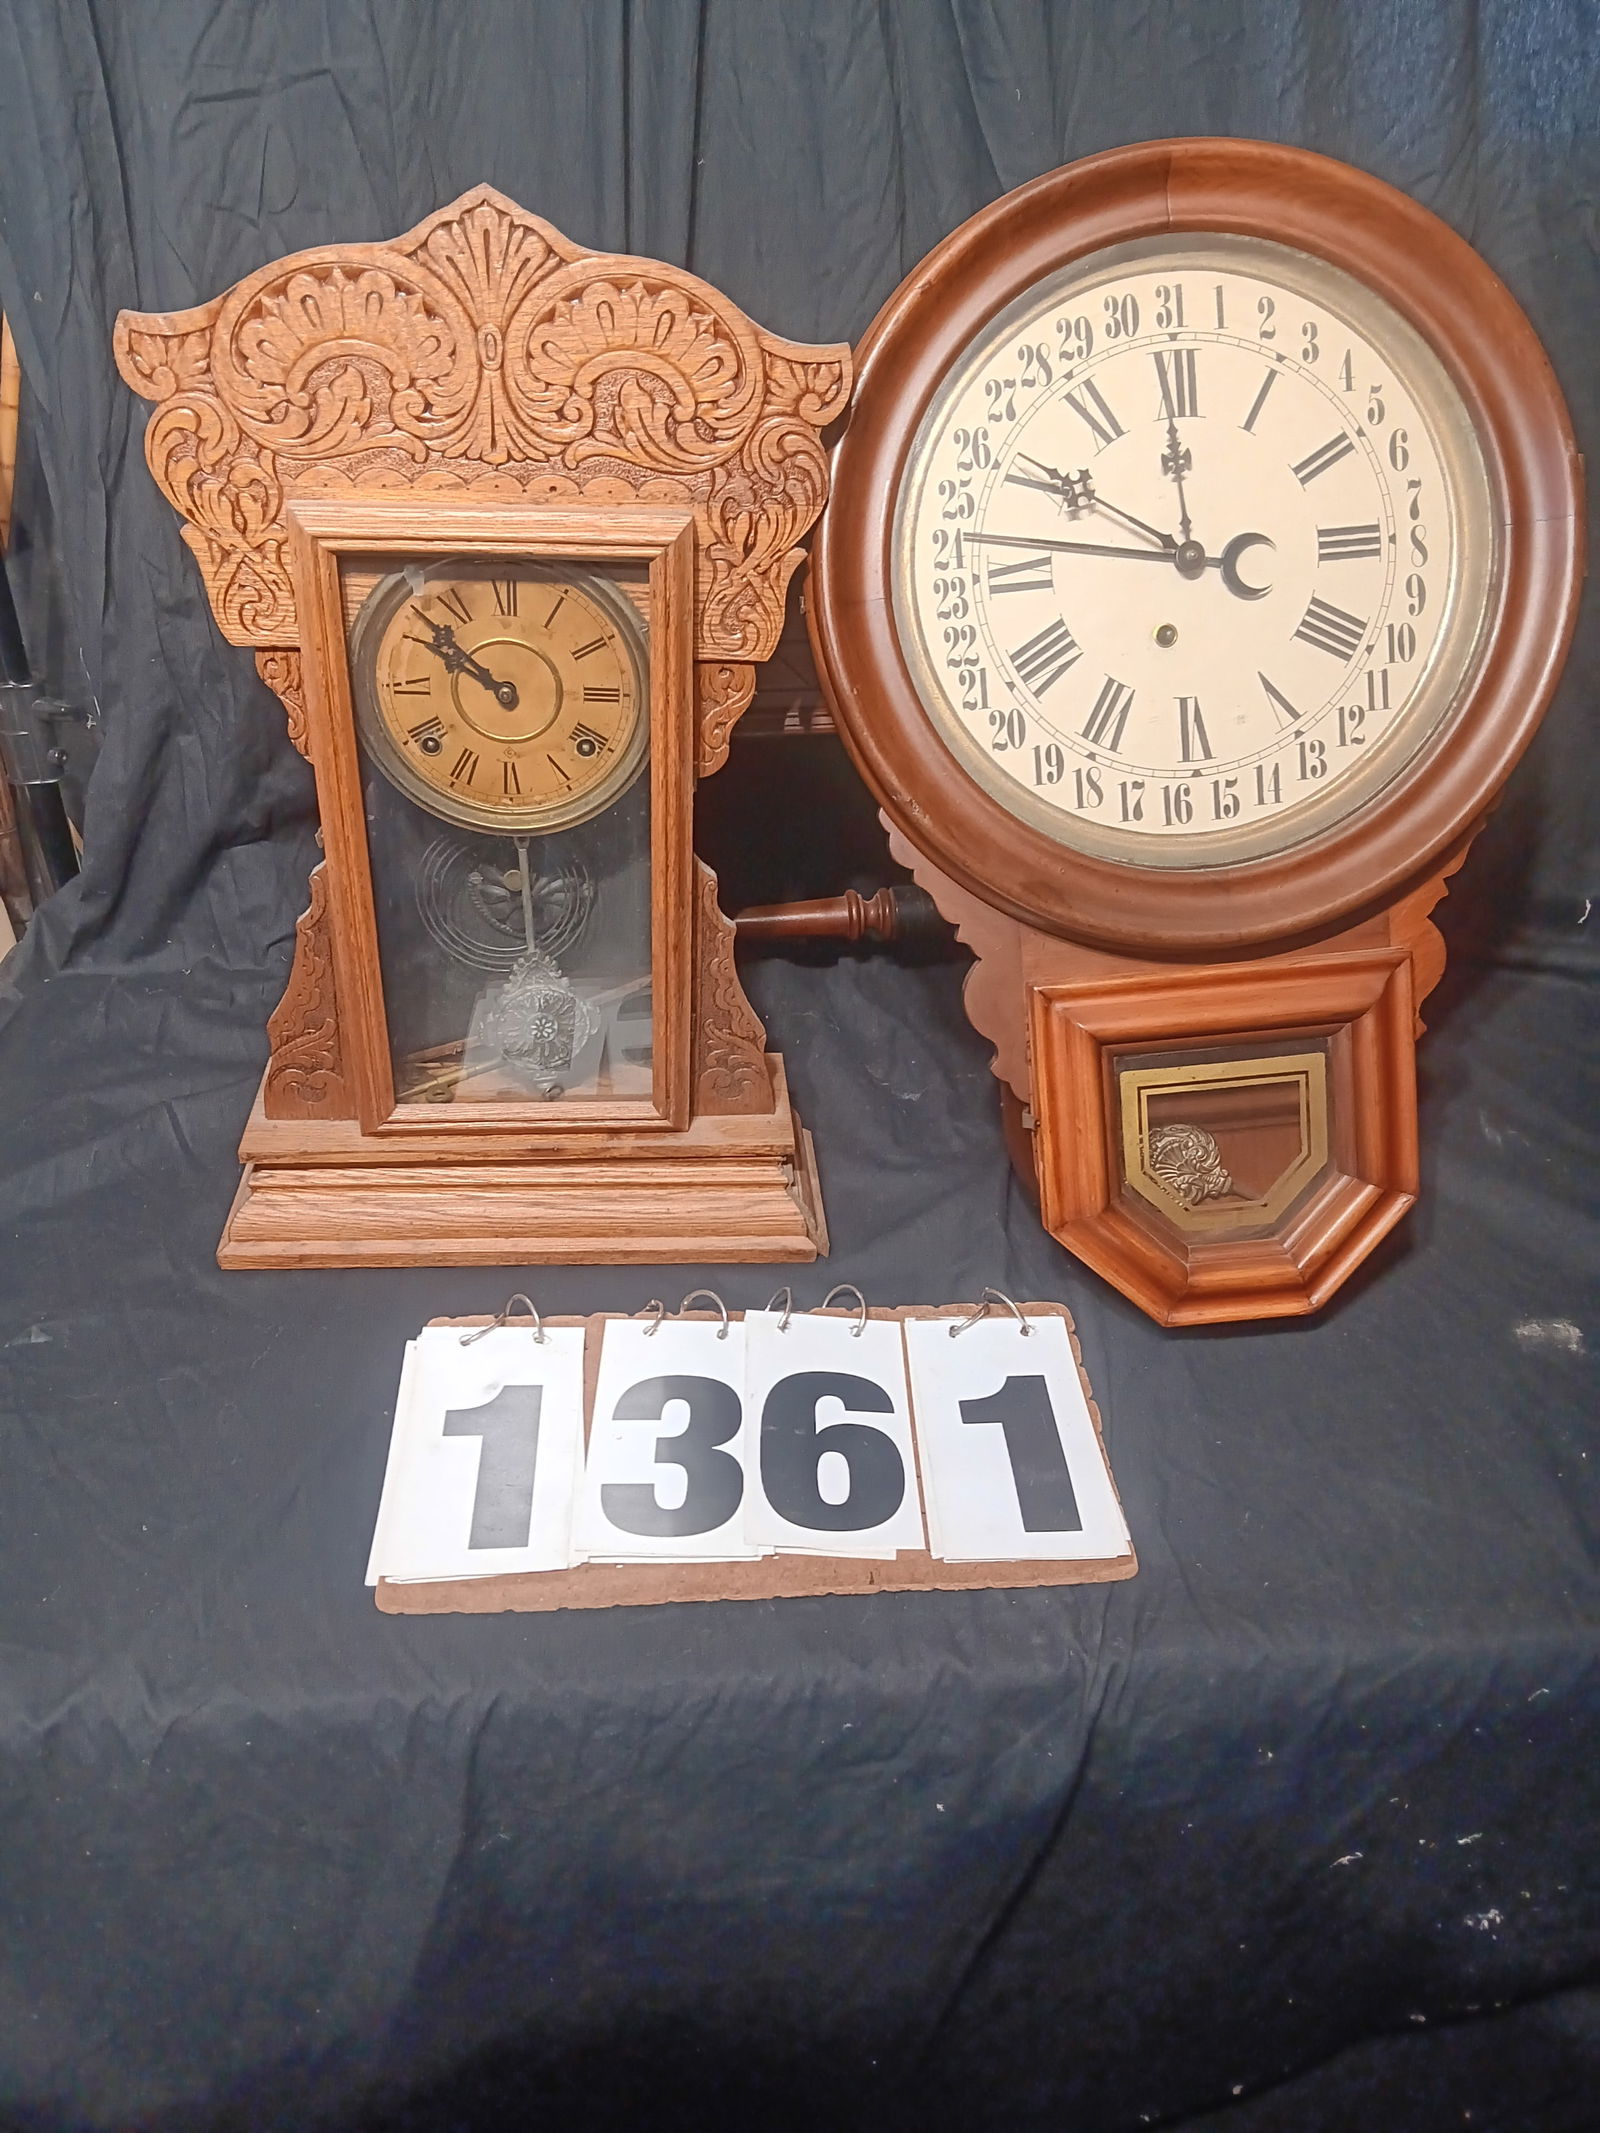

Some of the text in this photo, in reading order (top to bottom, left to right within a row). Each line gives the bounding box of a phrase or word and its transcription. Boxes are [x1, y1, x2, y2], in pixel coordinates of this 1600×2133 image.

[1104, 293, 1140, 338] 30
[1156, 283, 1189, 329] 31
[1213, 285, 1229, 330] 1
[1257, 296, 1277, 340] 2
[1056, 316, 1094, 361] 29
[1302, 322, 1320, 364] 3
[1017, 343, 1053, 387] 28
[1146, 348, 1206, 421] XII
[1338, 349, 1355, 392] 4
[985, 379, 1017, 423] 27
[1059, 374, 1130, 457] XI
[1238, 365, 1285, 435] I
[1368, 384, 1385, 426] 5
[954, 427, 991, 471] 26
[1287, 427, 1359, 491] II
[1389, 428, 1409, 471] 6
[939, 477, 975, 520] 25
[1406, 477, 1422, 521] 7
[933, 528, 966, 571] 24
[1316, 518, 1382, 567] III
[1410, 525, 1428, 567] 8
[987, 550, 1055, 601] IX
[1406, 573, 1427, 616] 9
[933, 577, 968, 619] 23
[943, 624, 979, 668] 22
[1290, 590, 1370, 668] IIII
[1384, 623, 1416, 664] 10
[1006, 614, 1084, 704] VIII
[958, 667, 993, 710] 21
[1257, 671, 1308, 734] V
[1364, 668, 1392, 712] 11
[989, 709, 1026, 751] 20
[1075, 674, 1136, 755] VII
[1174, 696, 1217, 763] VI
[1336, 704, 1366, 747] 12
[1033, 743, 1064, 786] 19
[1296, 739, 1328, 781] 13
[1072, 765, 1104, 810] 18
[1118, 781, 1145, 823] 17
[1161, 782, 1194, 827] 16
[1210, 777, 1242, 820] 15
[1253, 762, 1283, 806] 14
